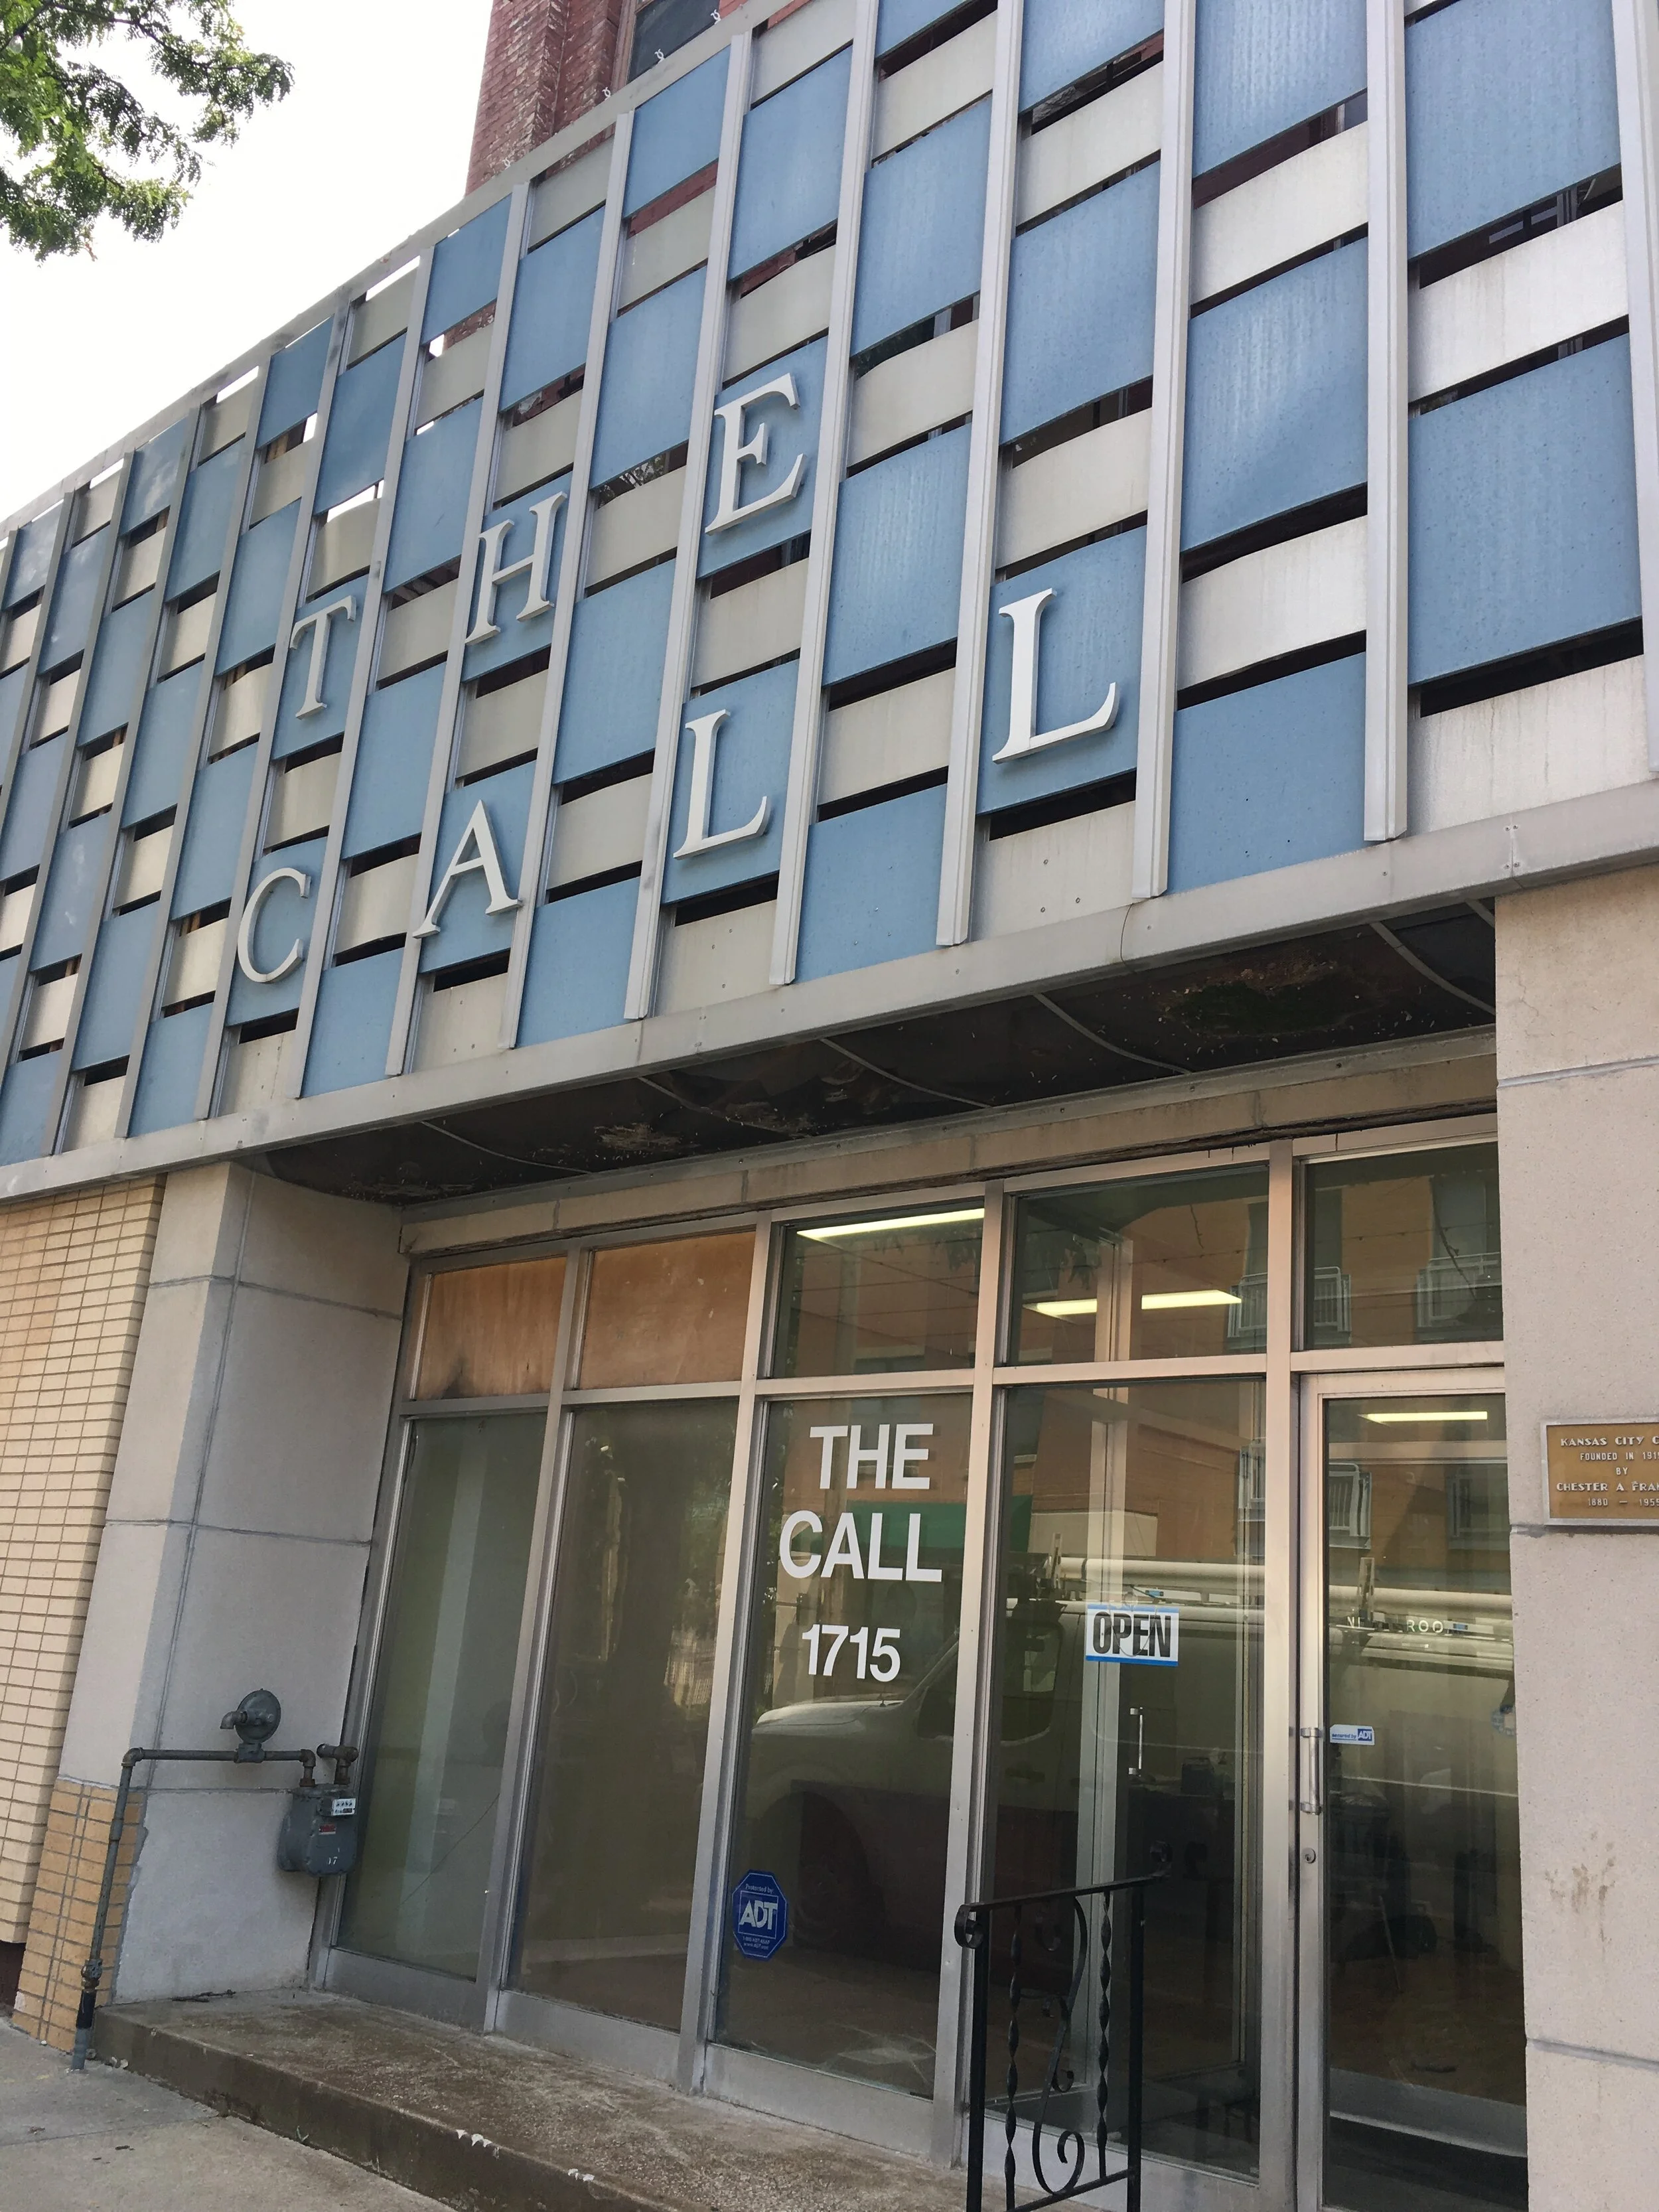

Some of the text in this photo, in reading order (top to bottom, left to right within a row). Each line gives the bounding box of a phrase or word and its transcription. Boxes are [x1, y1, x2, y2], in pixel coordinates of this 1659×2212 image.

[290, 373, 806, 720] THE
[238, 588, 1121, 984] CALL
[810, 1424, 934, 1489] THE
[1560, 1438, 1607, 1447] KANSAS
[1615, 1436, 1645, 1445] CITY
[1580, 1452, 1617, 1461] FOUNDED
[1626, 1451, 1634, 1460] IN
[1556, 1481, 1659, 1491] CHESTER A FRA
[779, 1510, 942, 1582] CALL
[802, 1624, 901, 1682] 1715
[1093, 1611, 1171, 1657] OPEN
[1358, 1730, 1372, 1740] ADT
[739, 1900, 778, 1930] ADT
